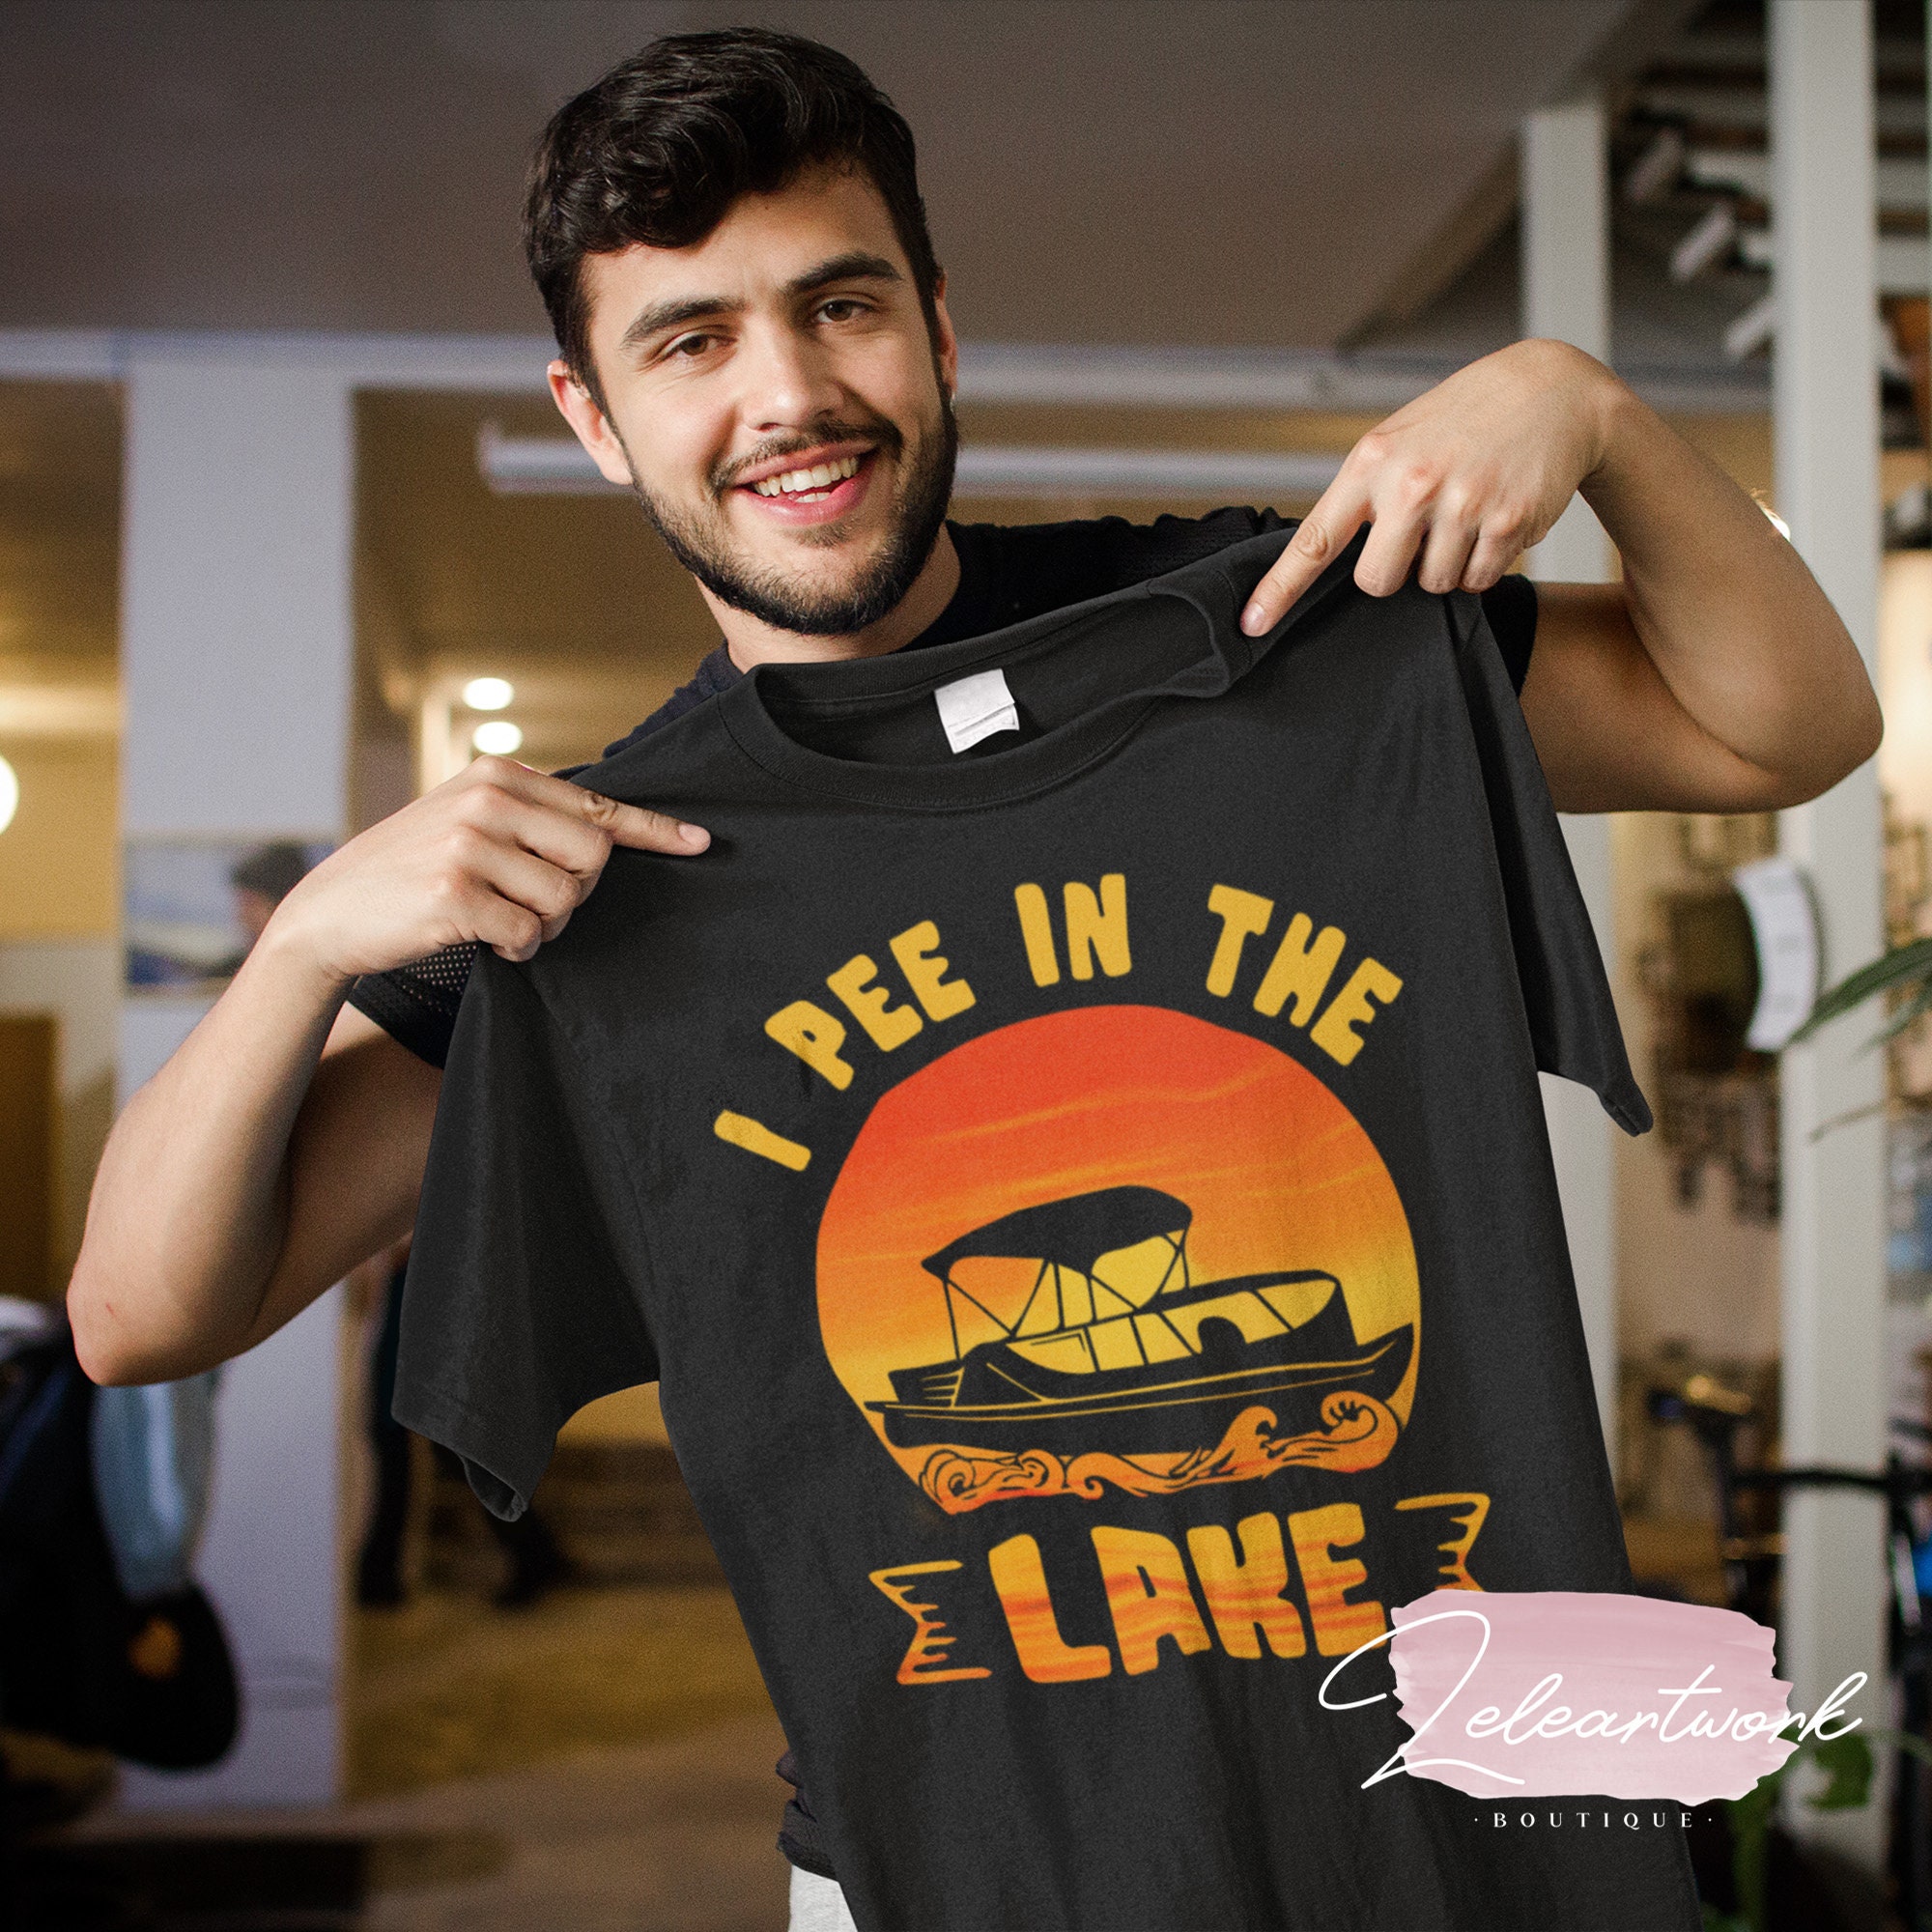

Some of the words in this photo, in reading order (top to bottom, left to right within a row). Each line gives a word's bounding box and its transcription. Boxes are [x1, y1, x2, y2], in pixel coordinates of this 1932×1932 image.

[714, 1109, 811, 1172] I
[764, 920, 977, 1091] PEE
[1014, 873, 1132, 987] IN
[1207, 884, 1404, 1066] THE
[988, 1503, 1387, 1683] LAKE
